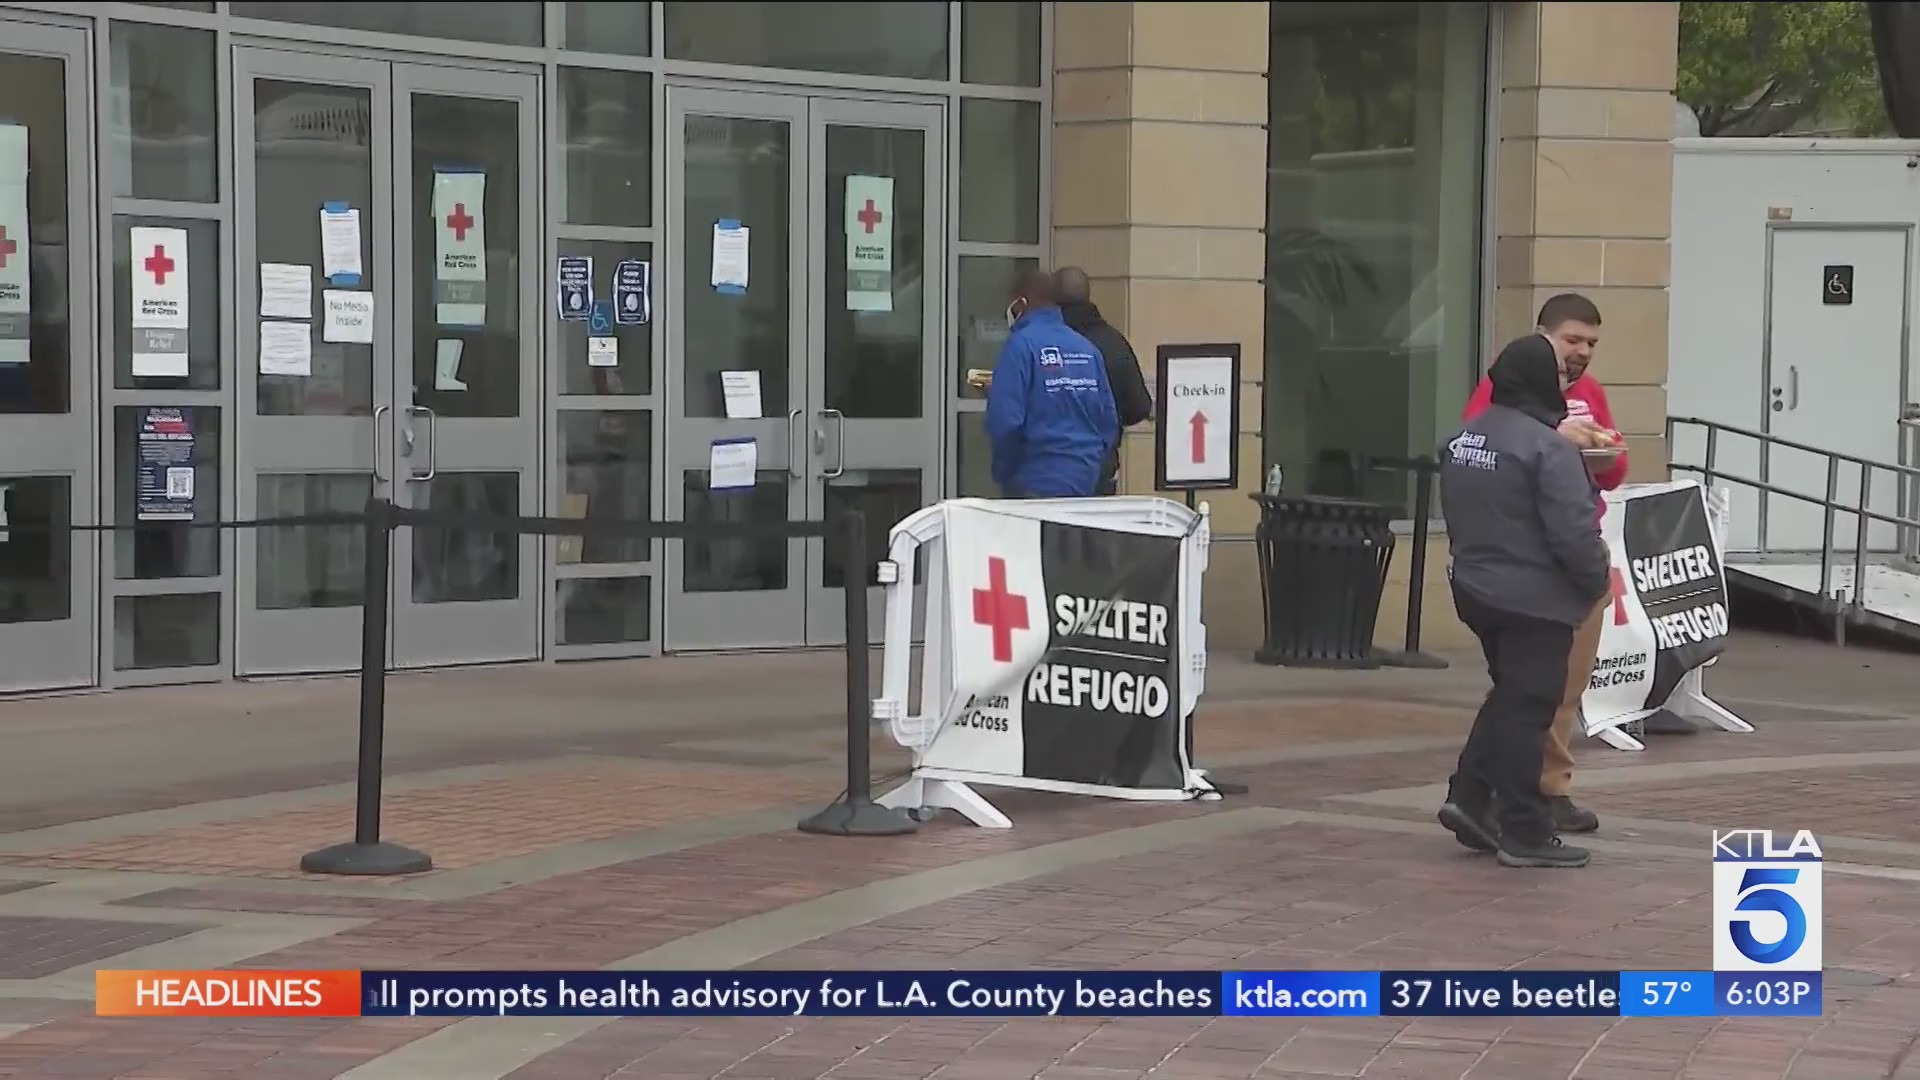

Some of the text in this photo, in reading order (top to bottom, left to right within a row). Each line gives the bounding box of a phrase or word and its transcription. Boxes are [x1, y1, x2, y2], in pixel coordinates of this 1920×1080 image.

[1173, 384, 1226, 397] Check-in
[1633, 545, 1715, 593] SHELTER
[1054, 594, 1168, 646] SHELTER
[1651, 602, 1728, 650] REFUGIO
[1593, 652, 1646, 670] American
[1028, 664, 1169, 718] REFUGIO
[1589, 670, 1645, 689] Red Cross
[972, 710, 1009, 732] Cross
